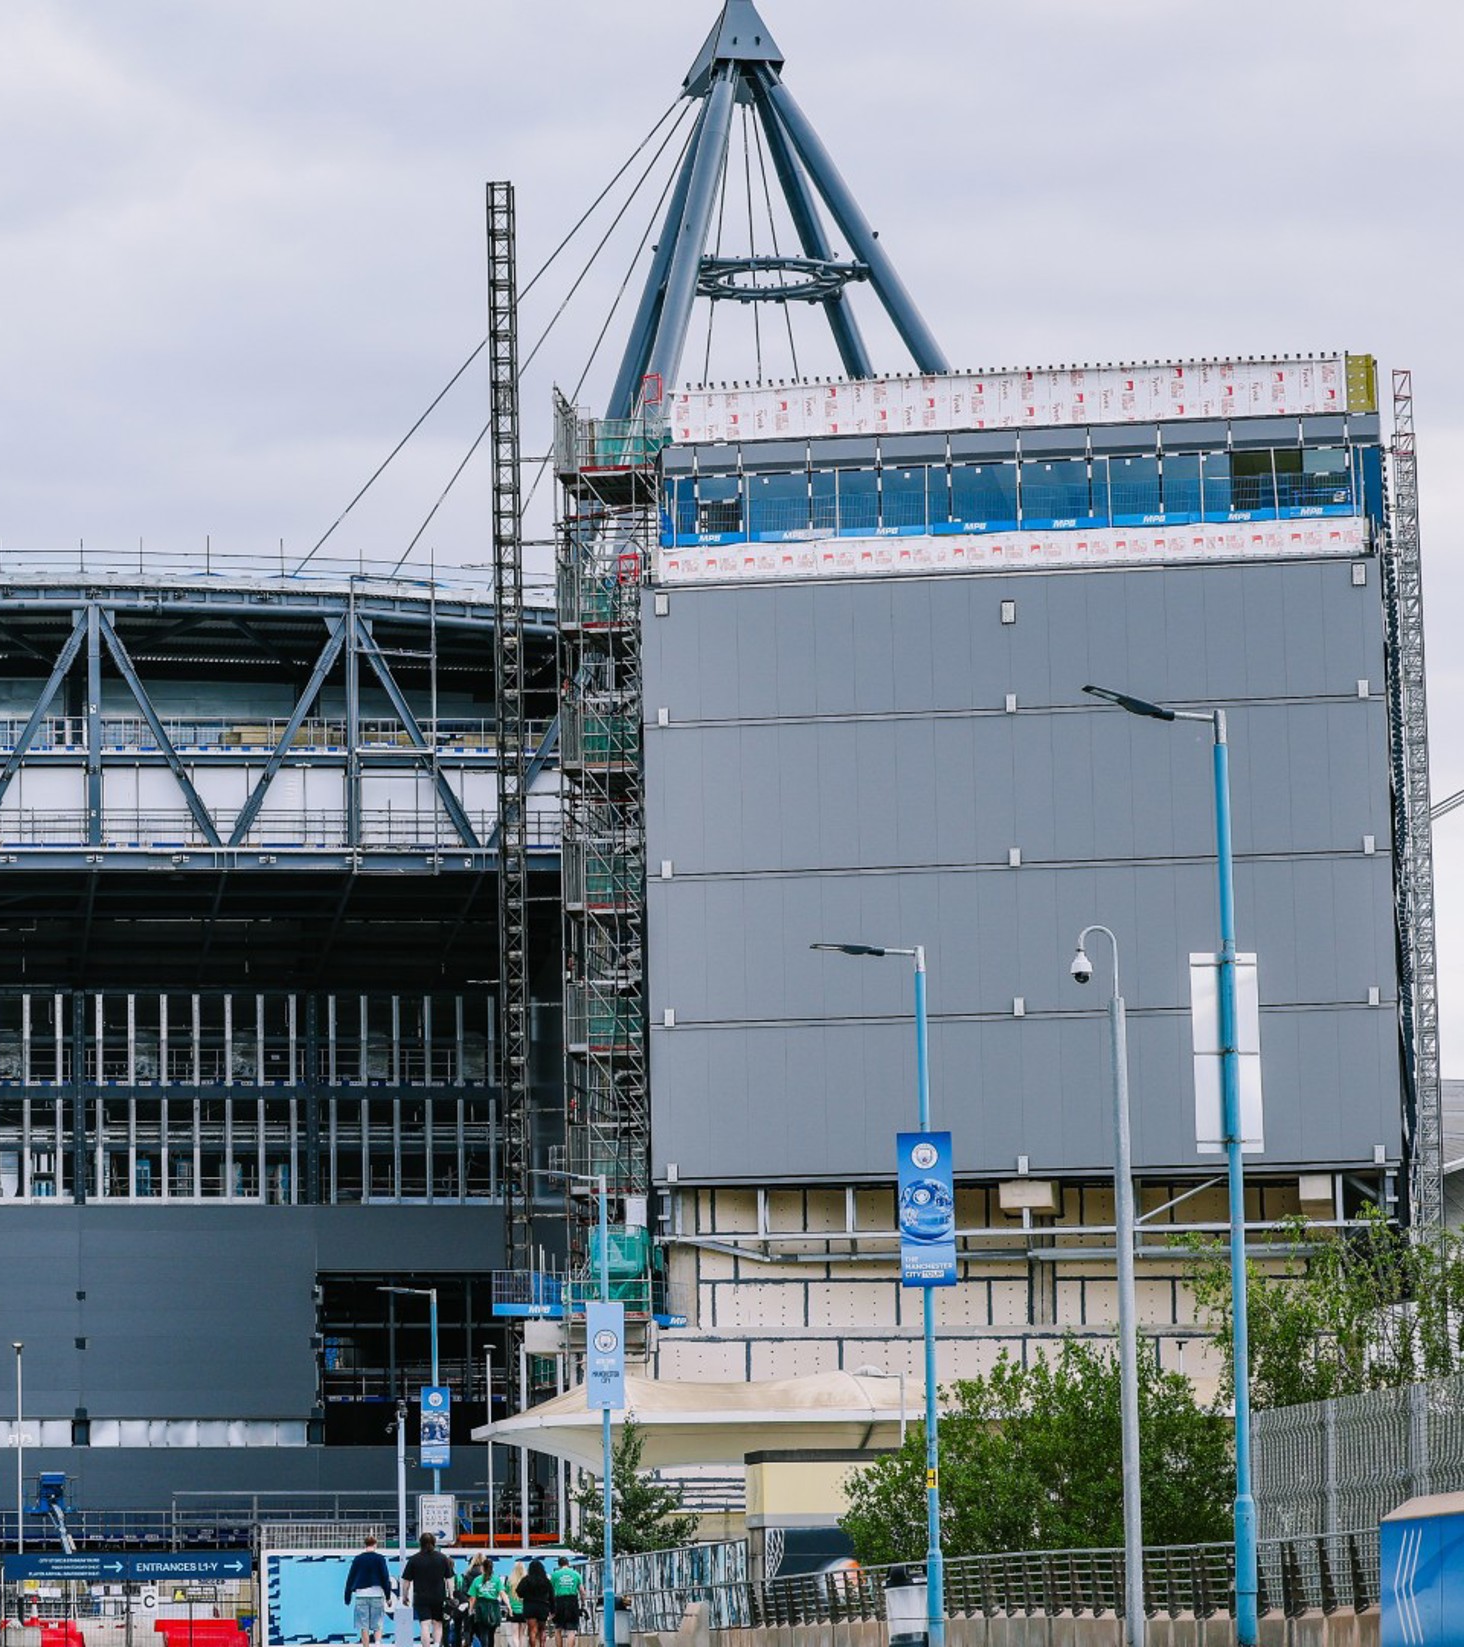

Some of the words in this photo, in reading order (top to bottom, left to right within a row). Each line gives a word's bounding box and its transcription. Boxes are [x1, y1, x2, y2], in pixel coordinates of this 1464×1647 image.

[1301, 507, 1323, 516] MPB
[1143, 515, 1166, 523] MPB
[1228, 512, 1251, 521] MPB
[670, 1317, 687, 1325] MP
[136, 1562, 197, 1572] ENTRANCES
[198, 1562, 219, 1571] L1-Y
[144, 1595, 155, 1608] C
